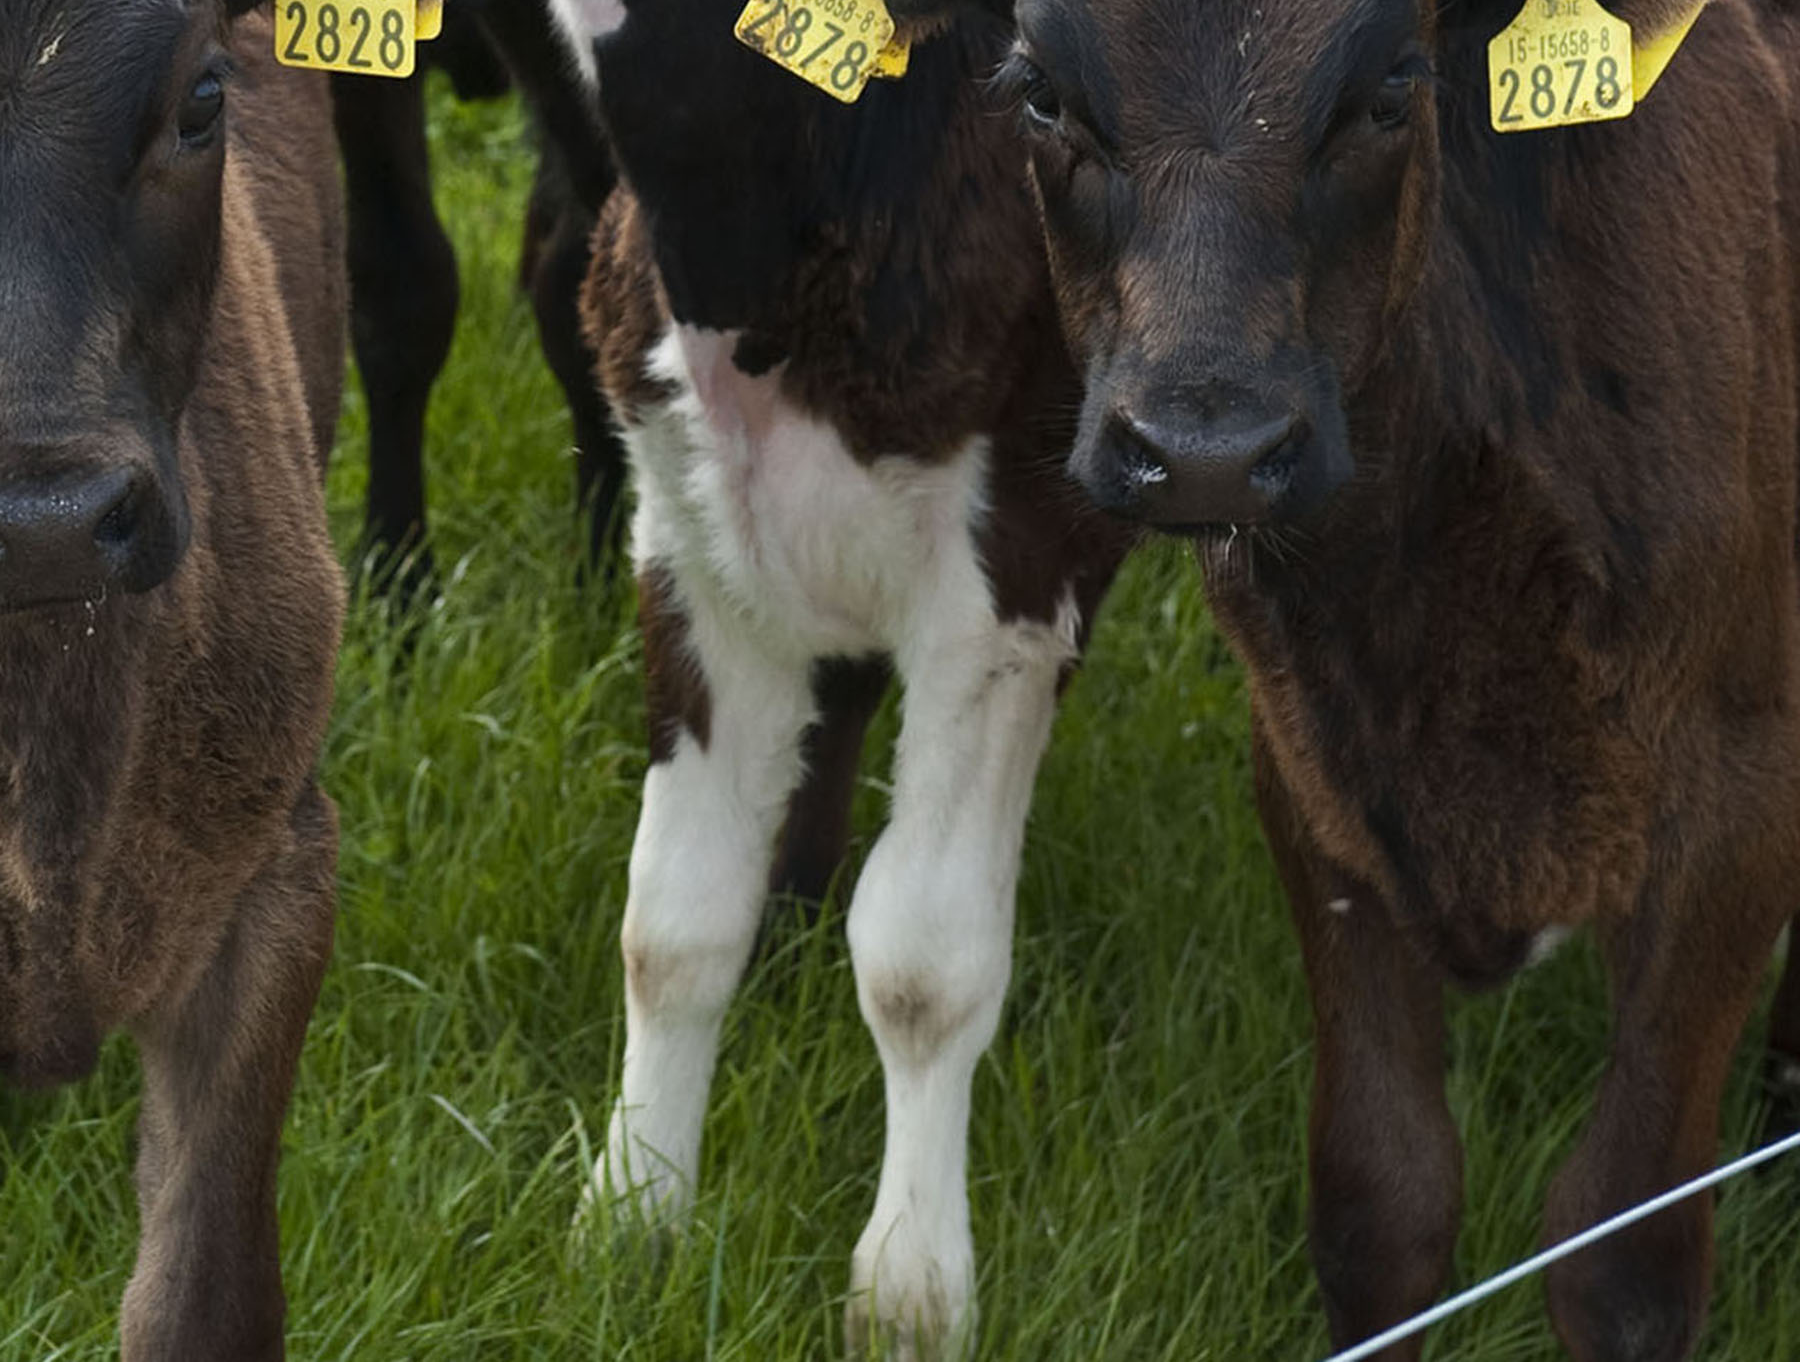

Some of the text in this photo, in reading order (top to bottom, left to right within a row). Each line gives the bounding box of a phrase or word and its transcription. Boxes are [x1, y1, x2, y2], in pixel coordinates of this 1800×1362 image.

[284, 0, 406, 70] 2828
[1508, 25, 1611, 64] 15-15658-8
[1498, 55, 1622, 124] 2878
